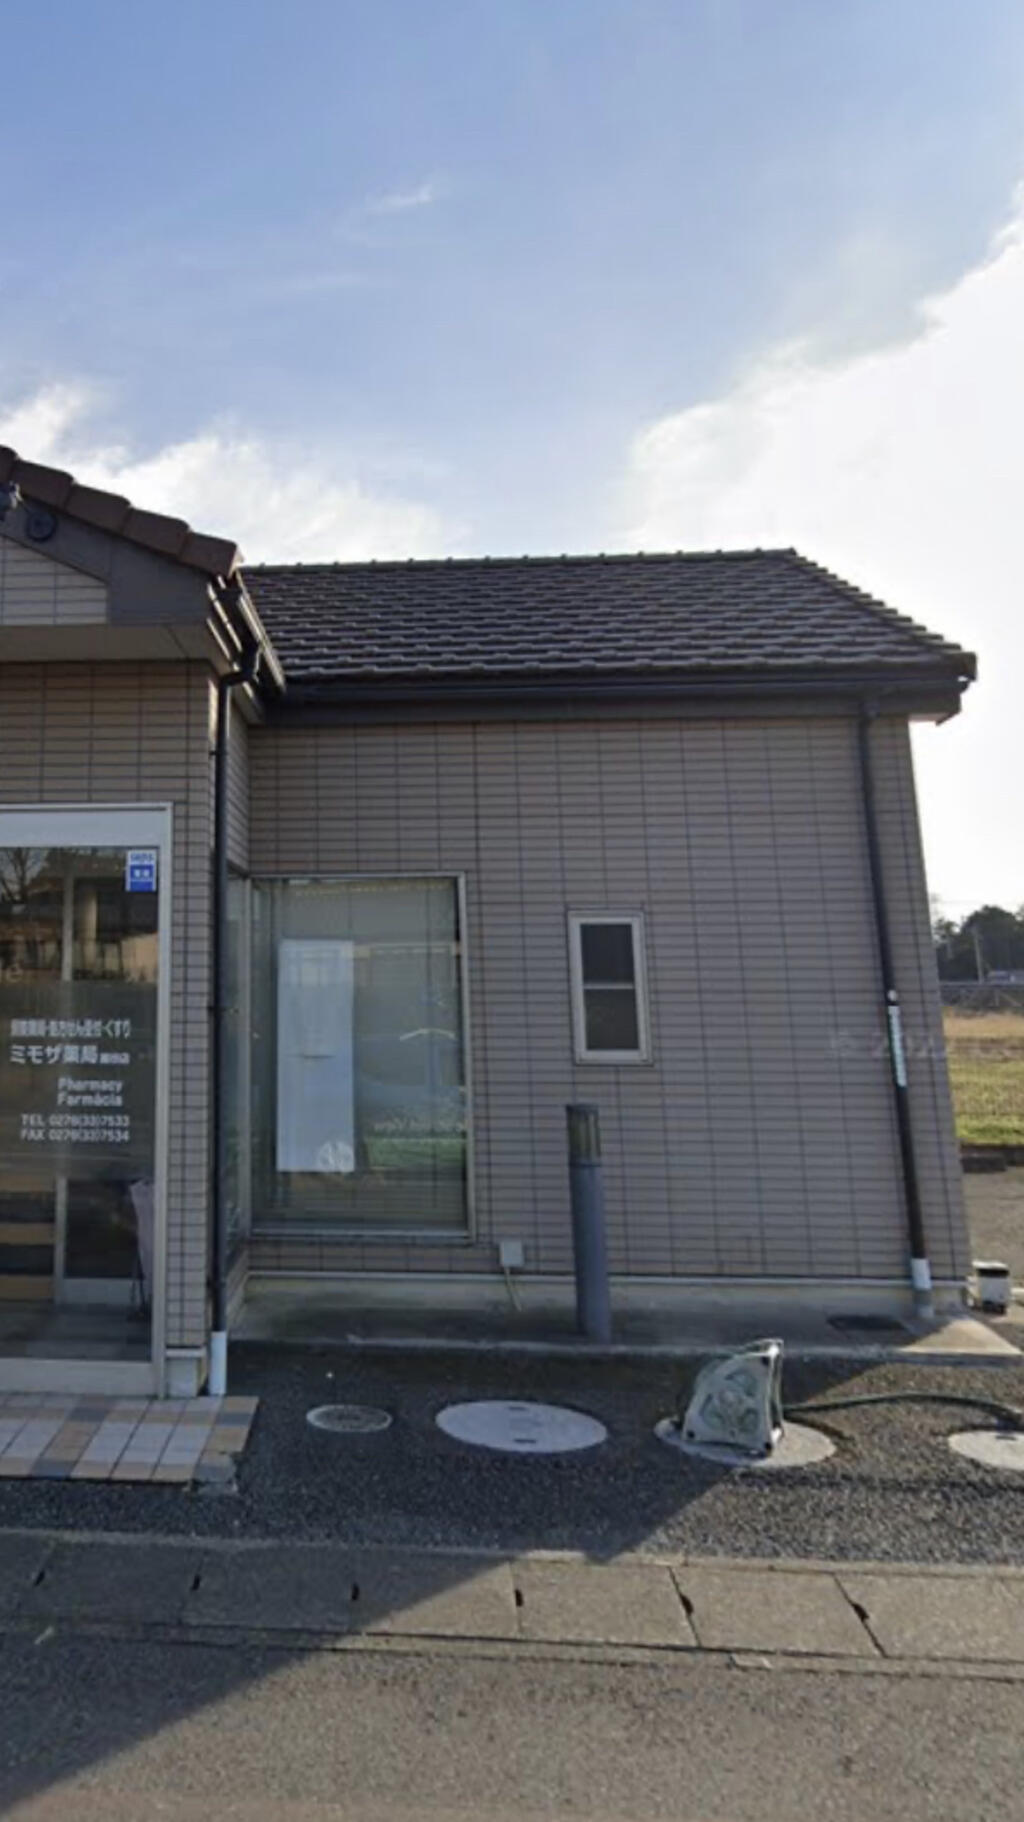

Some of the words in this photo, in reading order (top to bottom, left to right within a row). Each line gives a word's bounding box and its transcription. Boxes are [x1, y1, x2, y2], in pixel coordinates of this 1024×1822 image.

[57, 1077, 123, 1093] Pharmacy
[21, 1113, 45, 1126] TEL
[21, 1128, 45, 1141] FAX
